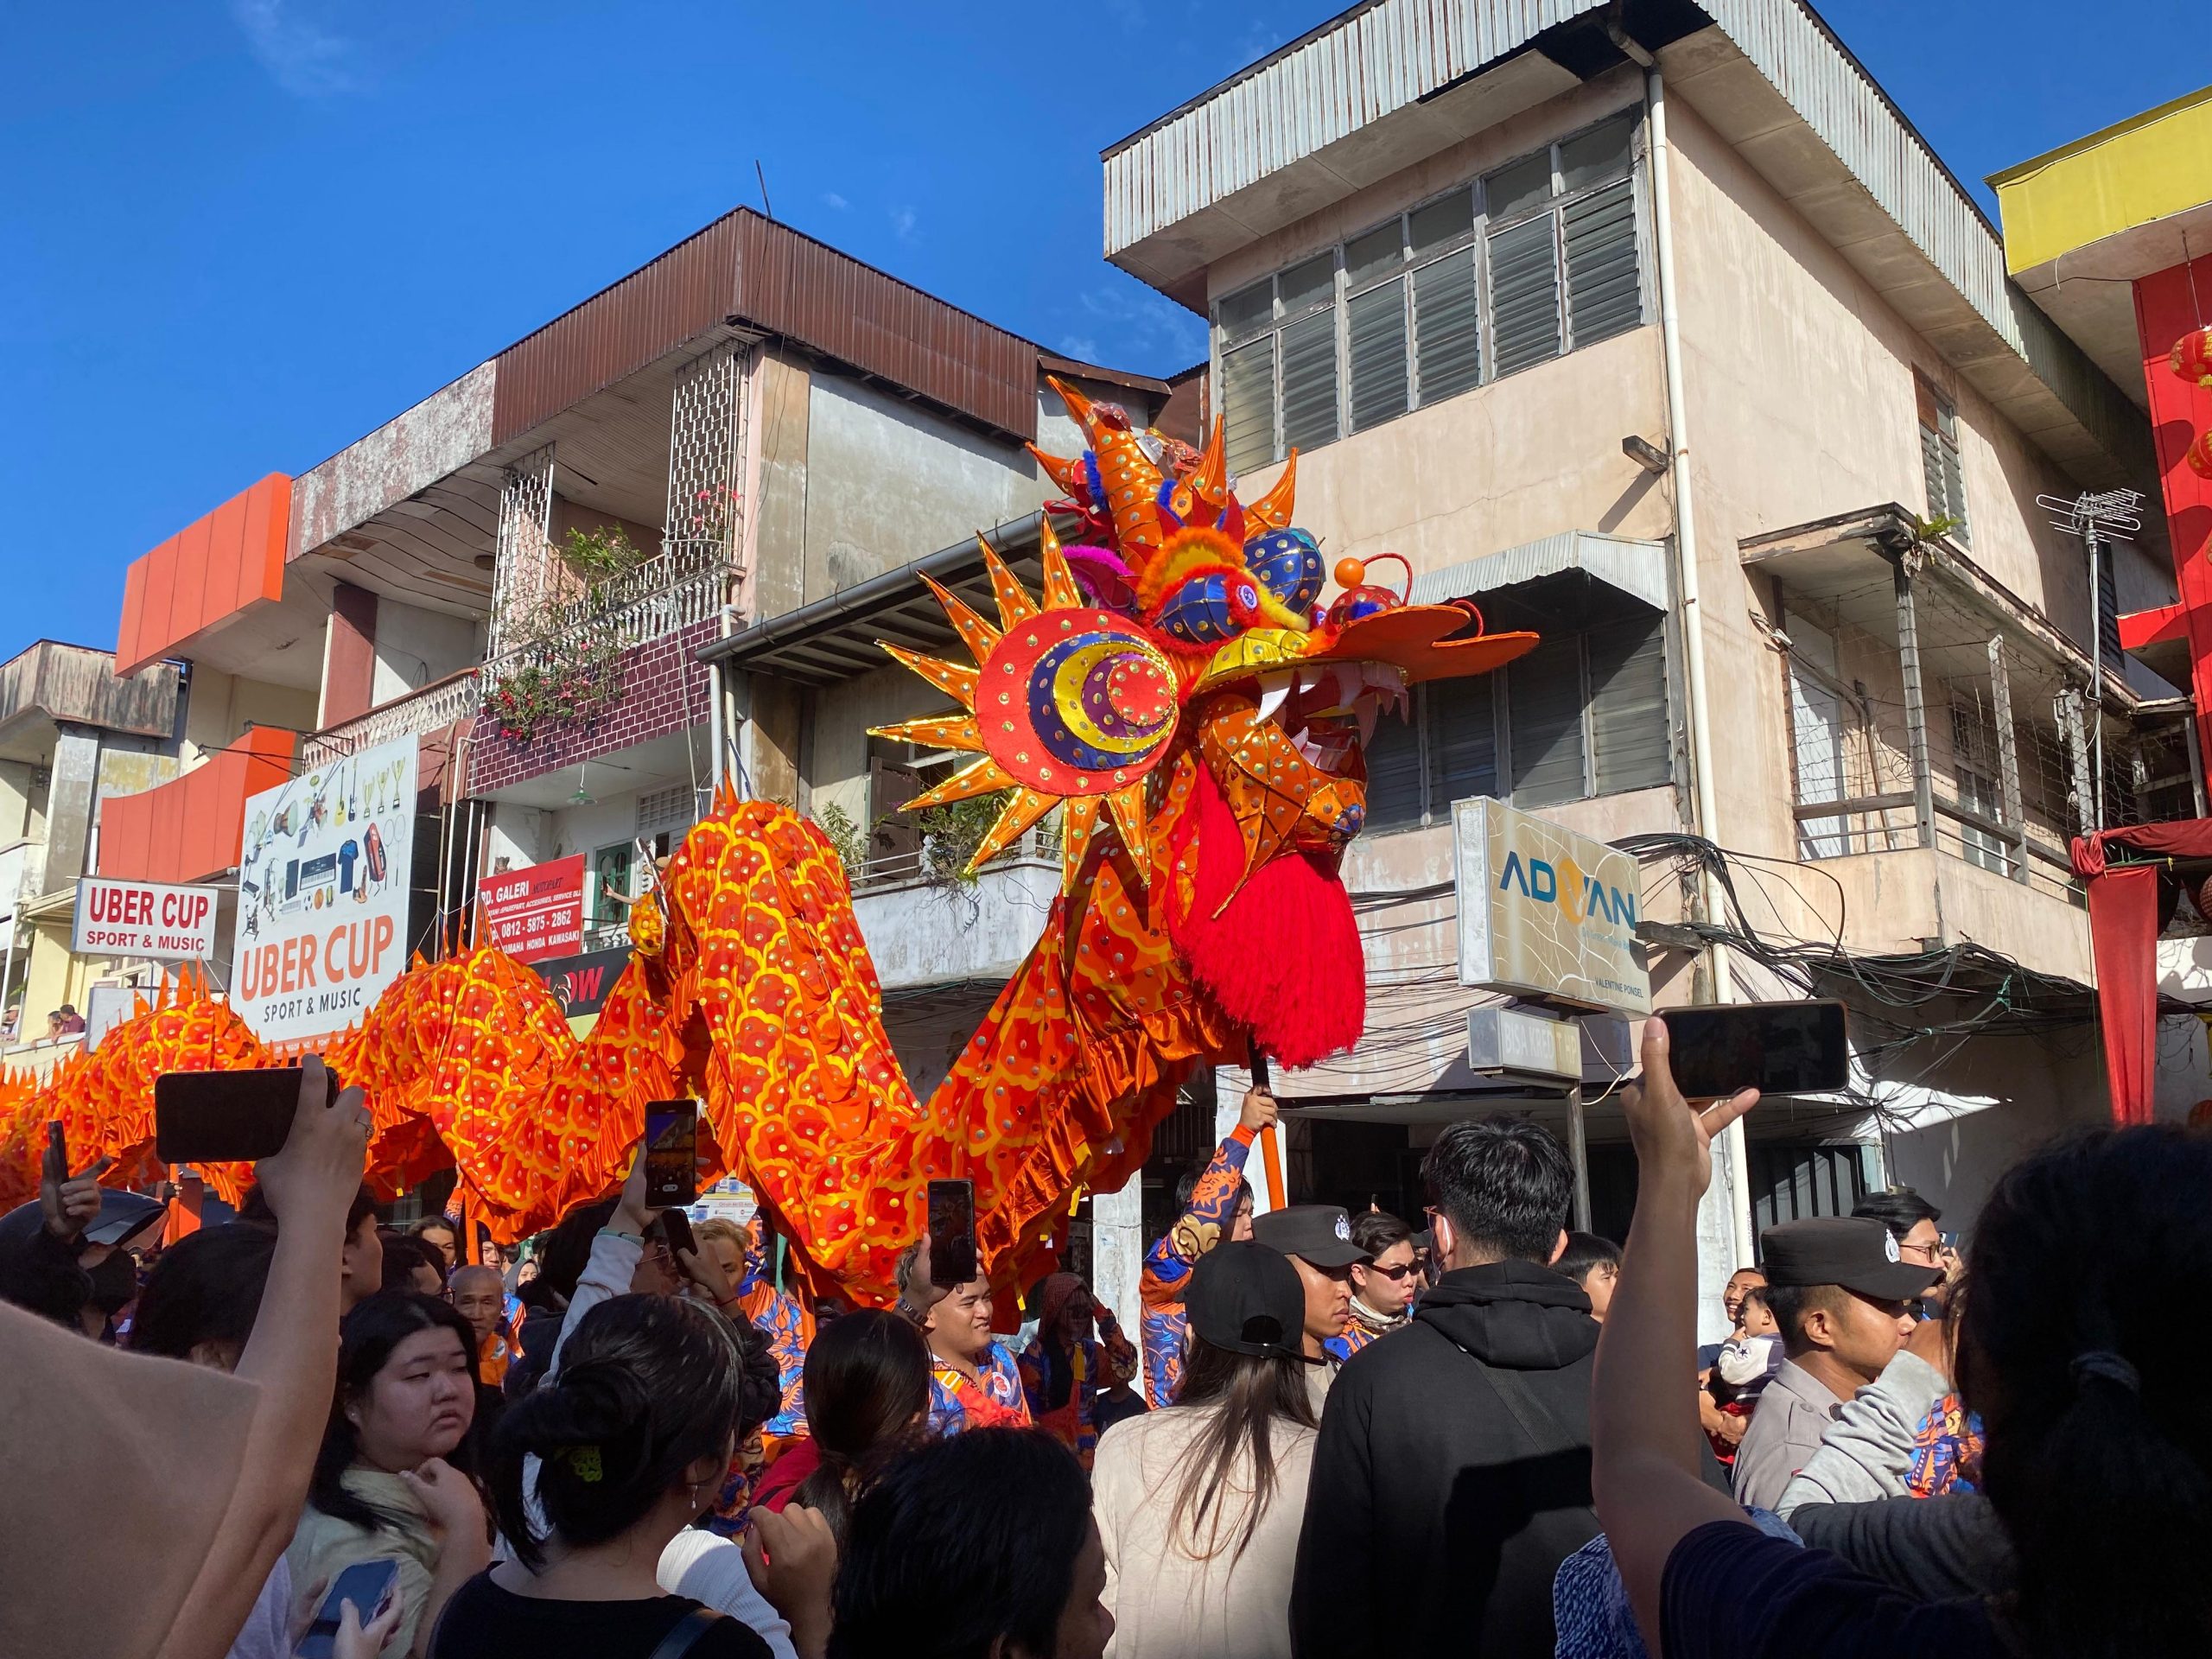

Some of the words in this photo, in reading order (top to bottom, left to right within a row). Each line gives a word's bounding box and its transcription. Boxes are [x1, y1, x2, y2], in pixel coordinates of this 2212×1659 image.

[496, 880, 530, 902] GALERI
[552, 891, 572, 902] SERVICE
[1499, 850, 1636, 931] ADVAN
[89, 887, 155, 926] UBER
[162, 893, 209, 930] CUP
[501, 921, 521, 938] 0812
[526, 915, 545, 933] 5875
[551, 910, 572, 928] 2862
[86, 931, 137, 947] SPORT
[142, 934, 152, 948] &
[158, 935, 205, 951] MUSIC
[502, 942, 524, 954] YAMAHA
[526, 937, 545, 950] HONDA
[548, 931, 580, 946] KAWASAKI
[240, 933, 318, 1002] UBER
[323, 914, 394, 984] CUP
[1594, 976, 1623, 993] VALENTINE
[1624, 984, 1644, 998] PONSEL
[264, 999, 303, 1023] SPORT
[306, 996, 315, 1015] &
[319, 987, 361, 1014] MUSIC
[1504, 1021, 1528, 1058] BISA
[1529, 1026, 1562, 1065] KREDT
[1564, 1033, 1578, 1065] HP
